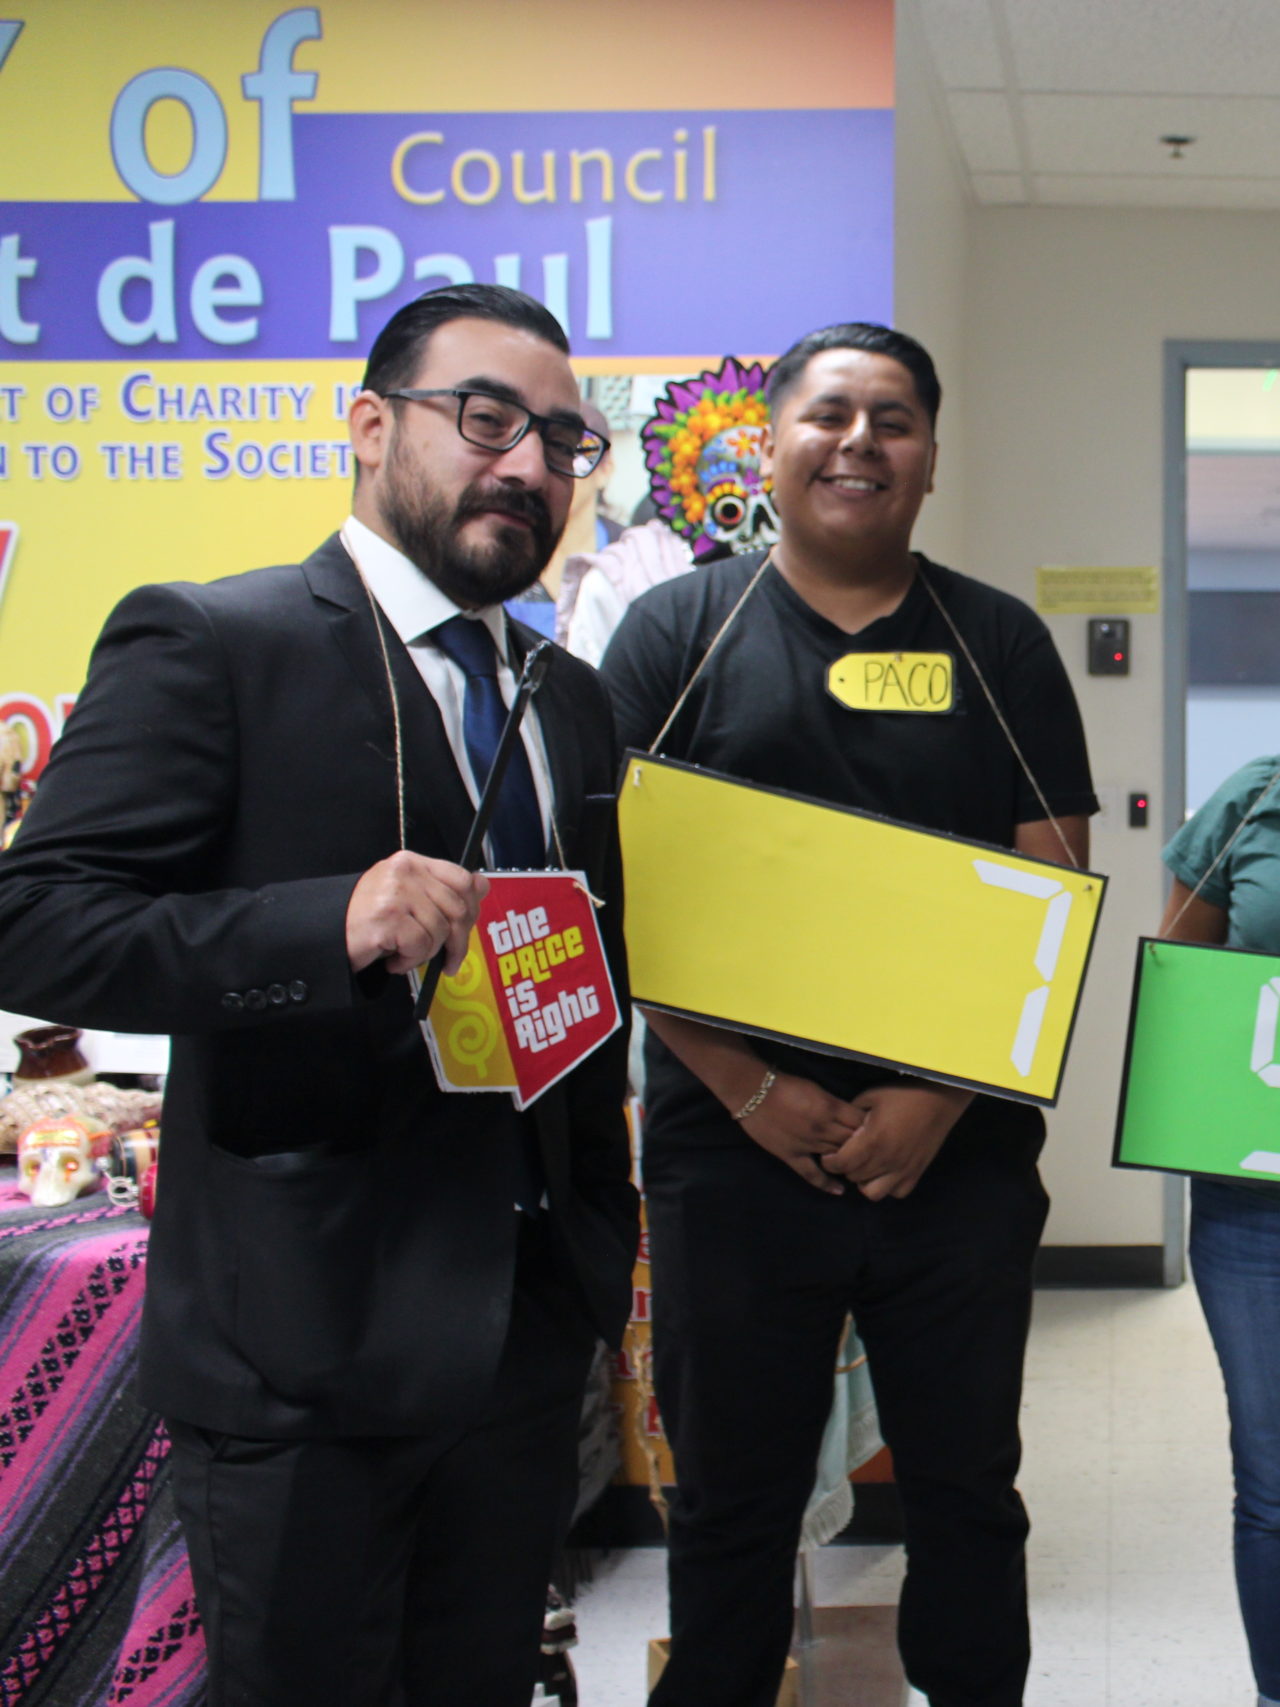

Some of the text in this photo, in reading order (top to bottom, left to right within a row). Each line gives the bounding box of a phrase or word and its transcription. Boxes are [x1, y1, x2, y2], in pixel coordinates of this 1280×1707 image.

[109, 6, 323, 205] of
[390, 126, 718, 206] Council
[96, 219, 264, 346] de
[204, 431, 353, 478] SOCIET
[864, 661, 949, 707] PACO
[487, 906, 551, 955] the
[972, 859, 1073, 1077] 7
[513, 985, 601, 1053] Right
